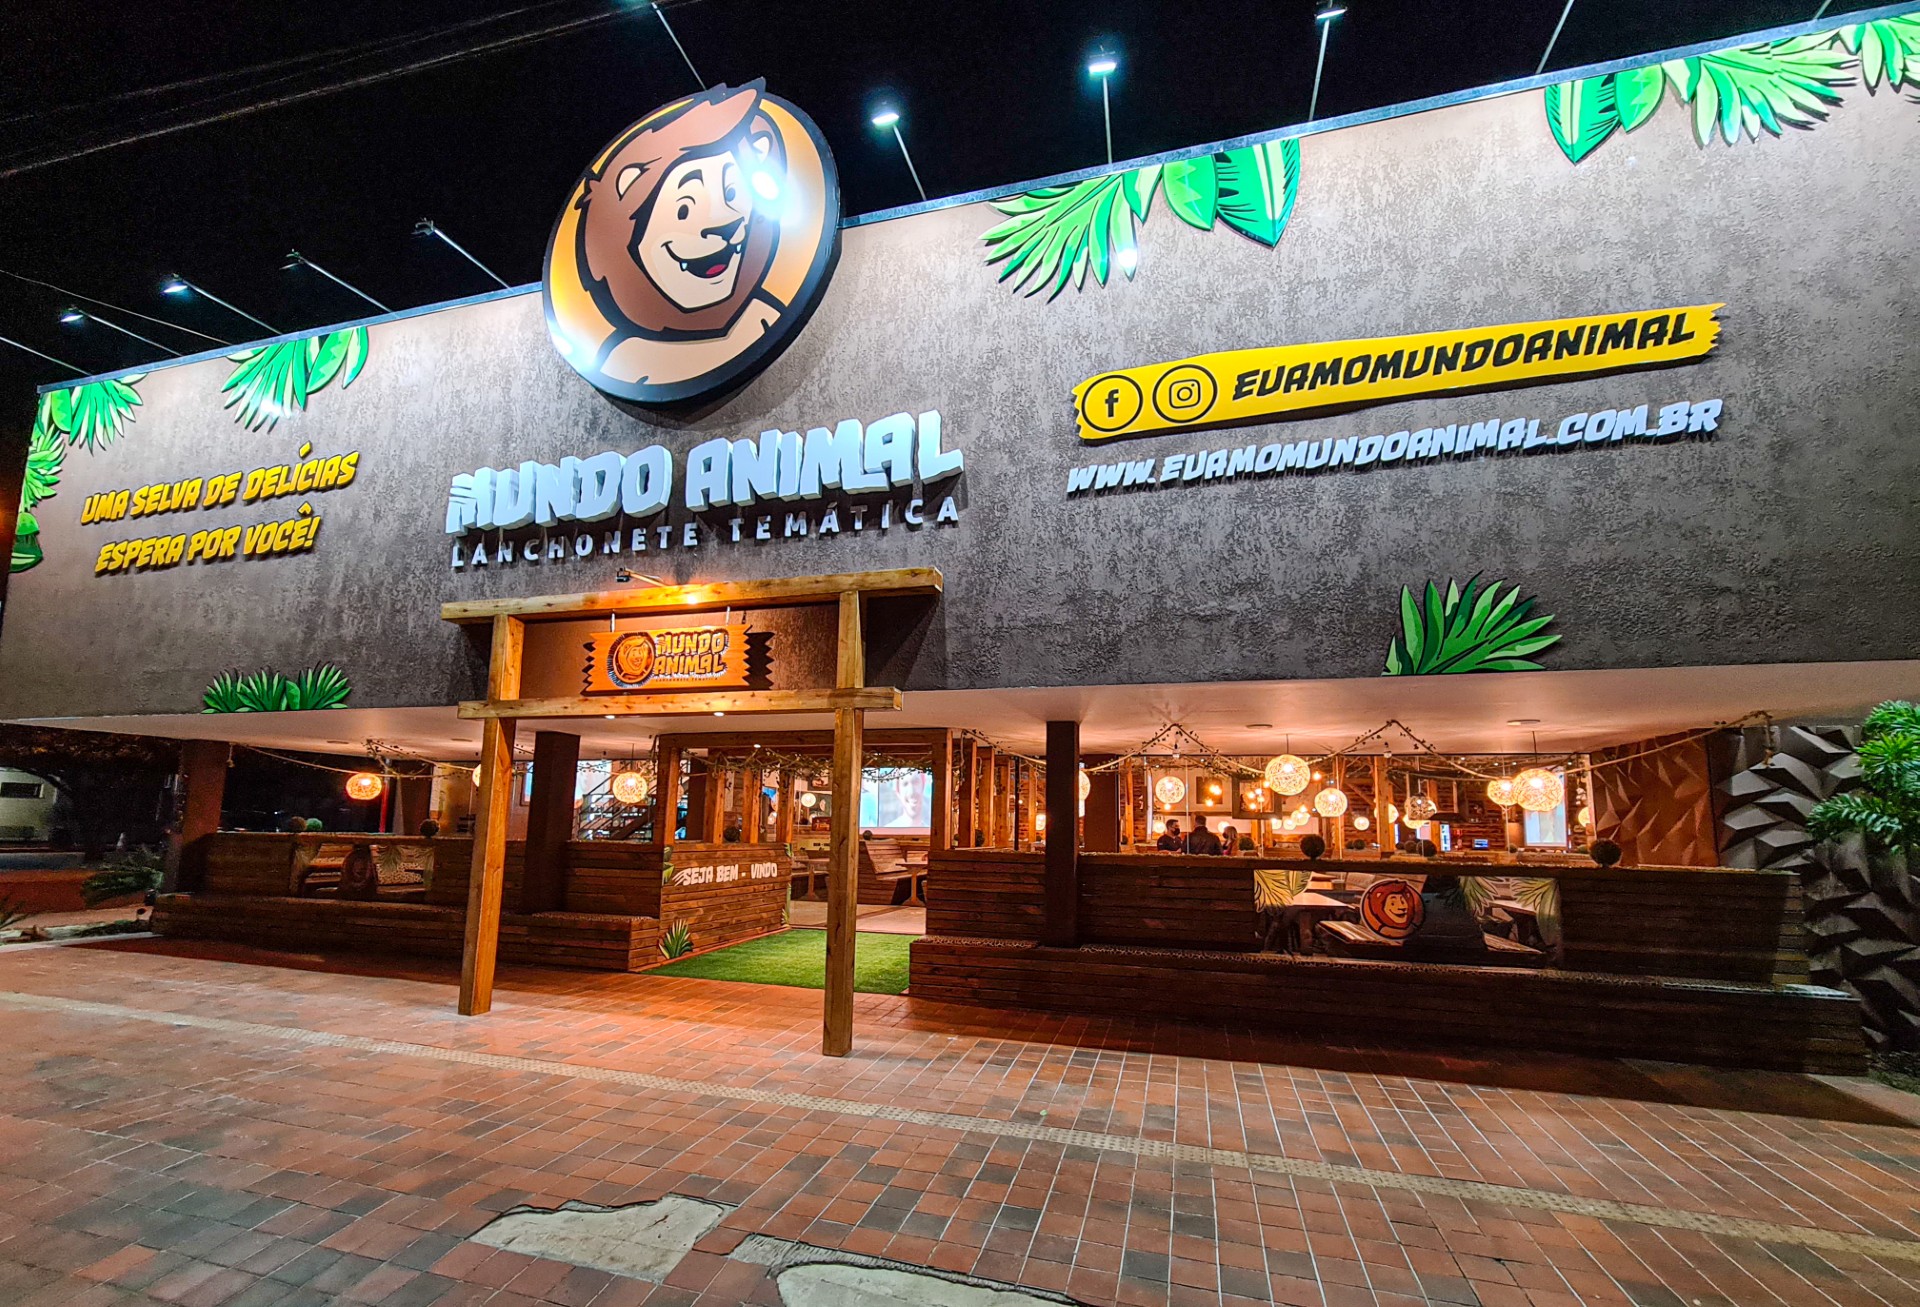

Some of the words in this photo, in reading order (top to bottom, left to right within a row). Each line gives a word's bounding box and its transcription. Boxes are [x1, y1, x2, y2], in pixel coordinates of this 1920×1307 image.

[1233, 313, 1696, 401] EUAMOMUNDOANIMAL
[80, 489, 130, 524] UMA
[130, 478, 203, 516] SELVA
[203, 471, 243, 508] DE
[242, 441, 360, 501] DELÍCIAS
[445, 444, 673, 534] MUNDO
[685, 409, 964, 512] ANIMAL
[1066, 399, 1723, 493] WWW.EUAMOMUNDOANIMAL.COM.BR
[94, 534, 187, 574] ESPERA
[187, 525, 242, 563] POR
[243, 501, 322, 556] VOCÊ!
[451, 522, 699, 567] LANCHONETE
[729, 495, 960, 543] TEMÁTICA
[655, 653, 726, 676] ANIMAL
[656, 631, 726, 655] MUNDO
[683, 865, 714, 886] SEJA
[716, 863, 739, 883] BEM
[751, 862, 778, 879] VINDO
